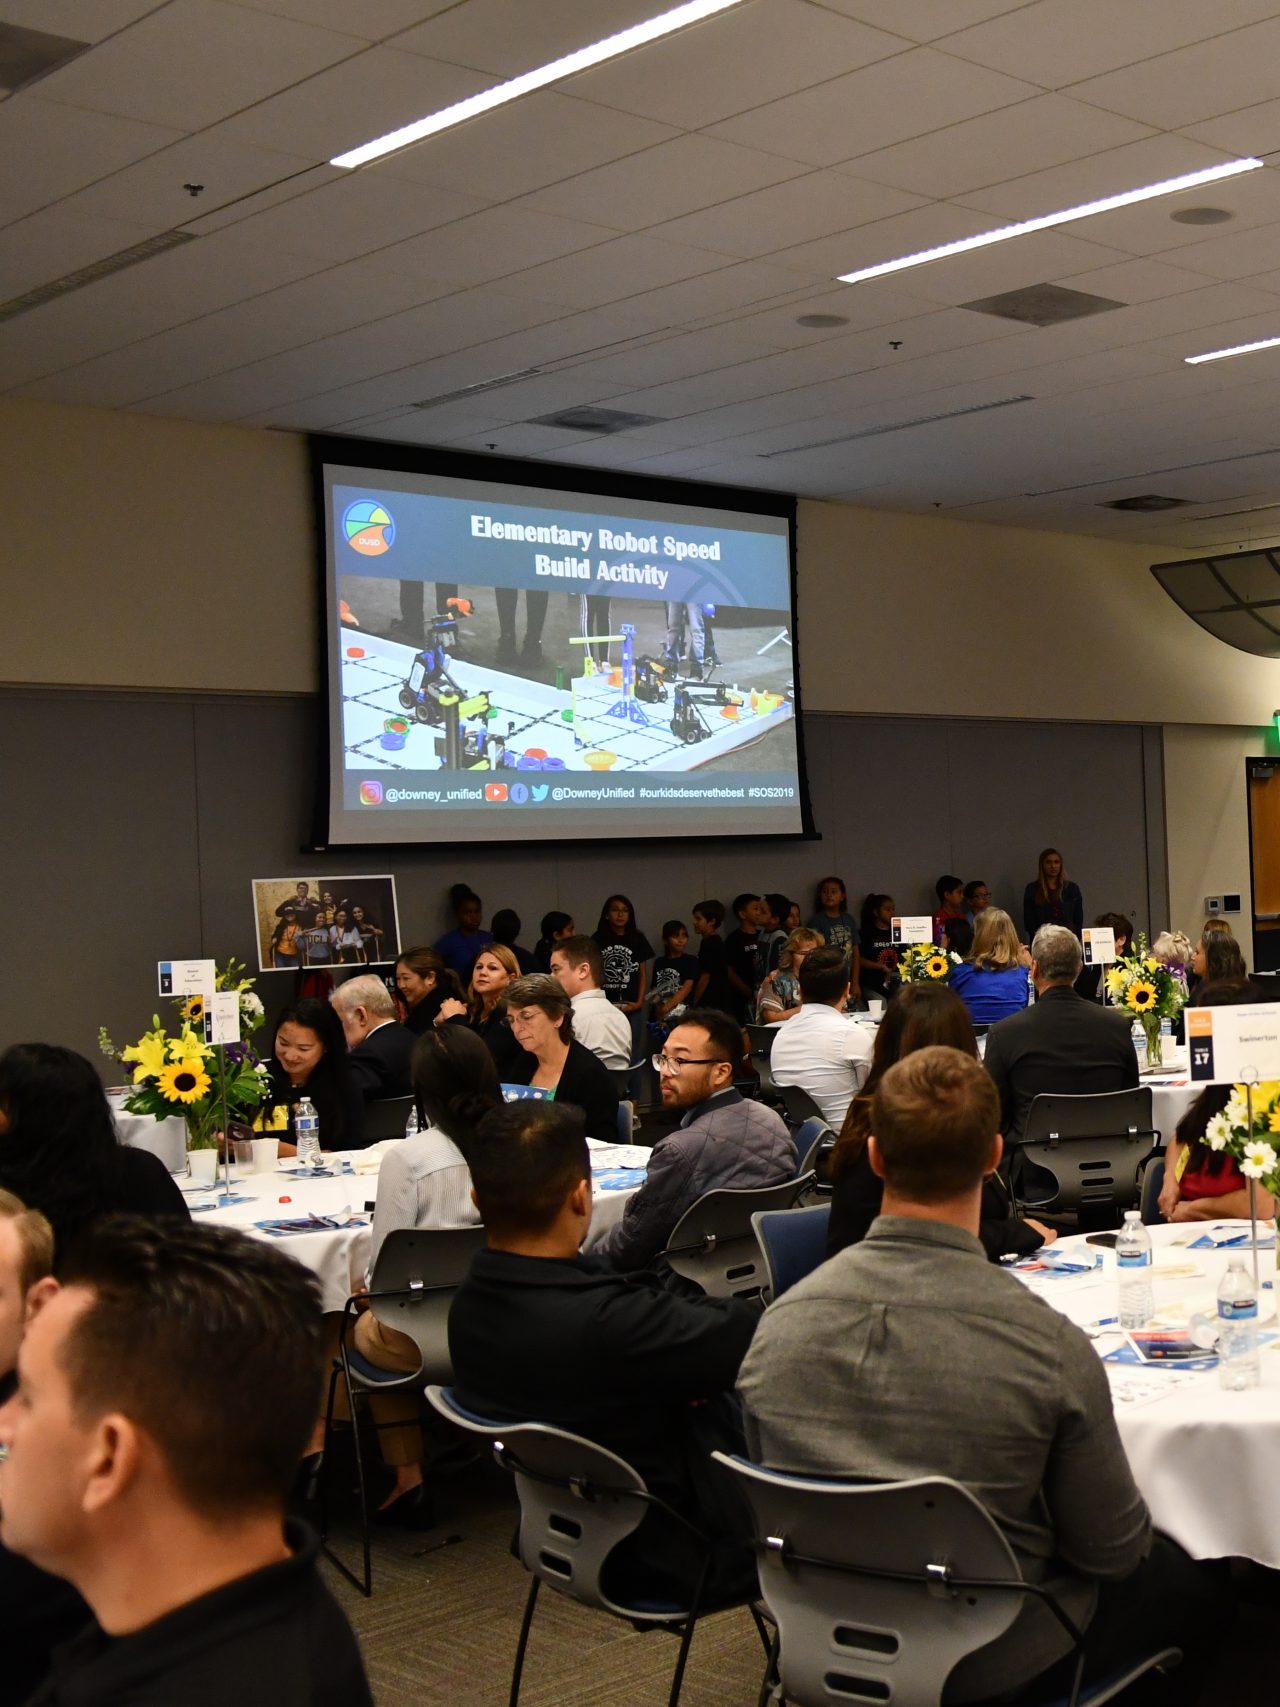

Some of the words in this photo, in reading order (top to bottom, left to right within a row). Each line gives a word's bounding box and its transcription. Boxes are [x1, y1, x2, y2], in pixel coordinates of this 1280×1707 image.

[470, 514, 593, 552] Elementary
[599, 529, 658, 555] Robot
[663, 535, 721, 561] Speed
[535, 554, 591, 580] Build
[596, 560, 669, 590] Activity
[385, 788, 483, 803] @downey_unified
[551, 787, 635, 801] @DowneyUnified
[639, 787, 745, 799] #ourkidsdeservethebest
[748, 787, 794, 798] #SOS2019
[1194, 1053, 1210, 1066] 17
